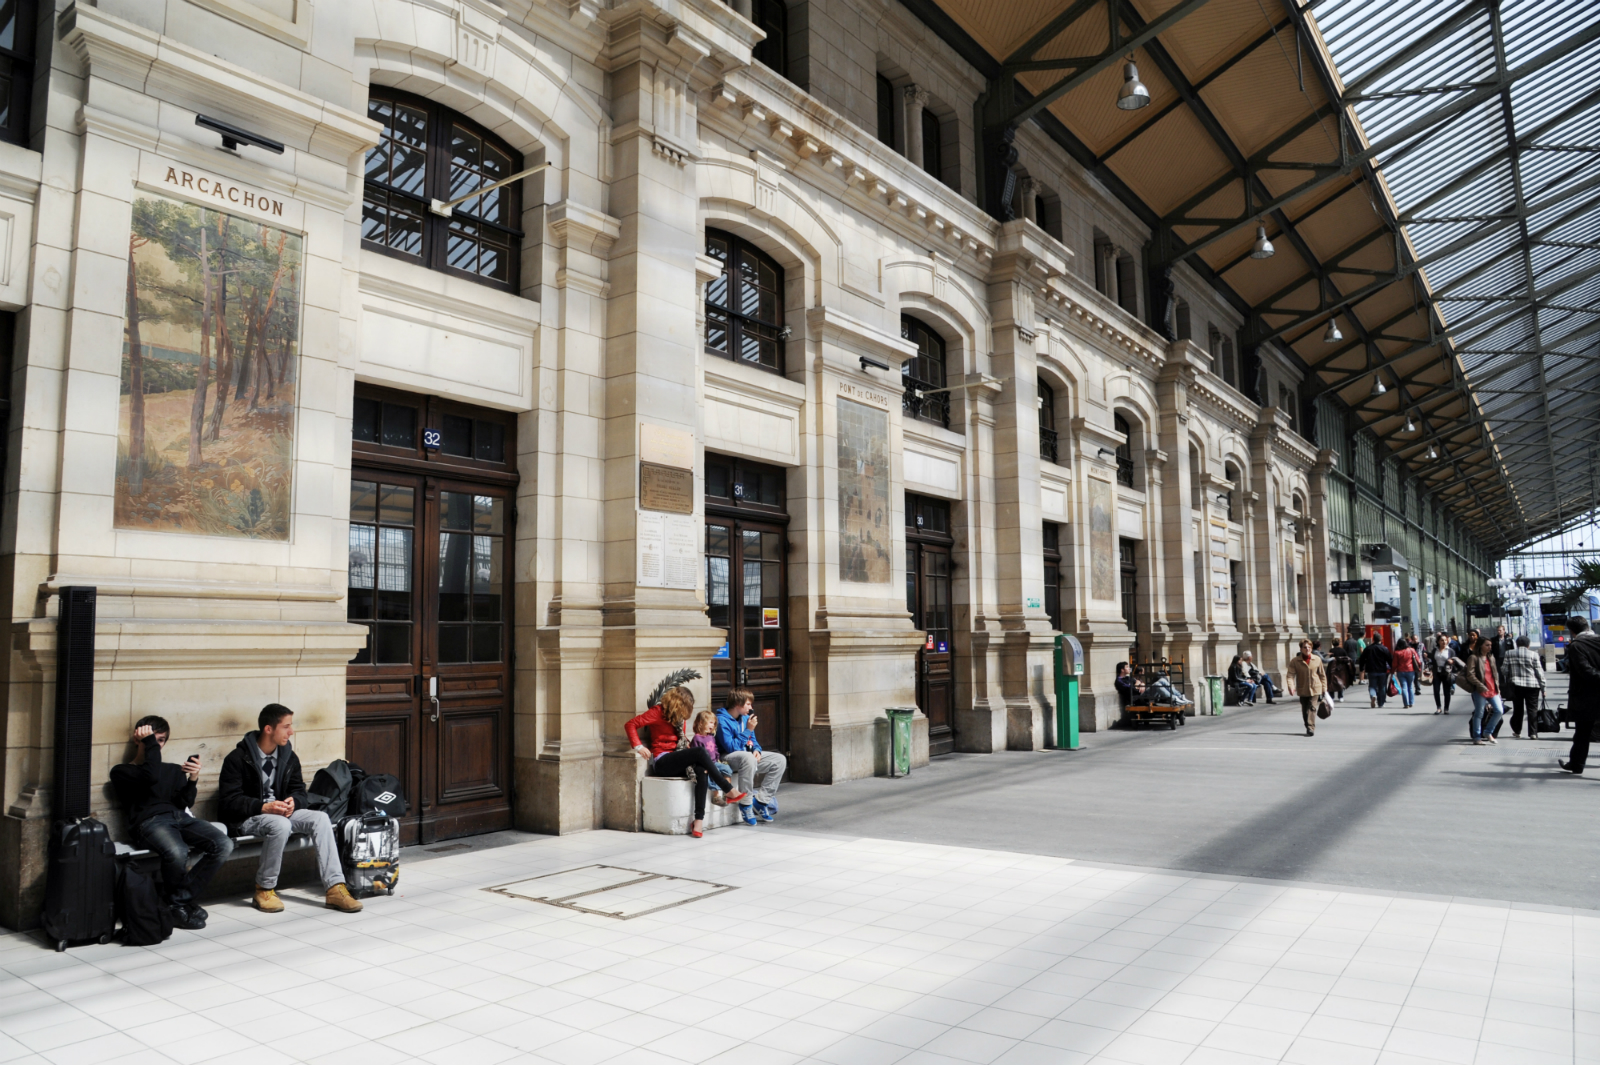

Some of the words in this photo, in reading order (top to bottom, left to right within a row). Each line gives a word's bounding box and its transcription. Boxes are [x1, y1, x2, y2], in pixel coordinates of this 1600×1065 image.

[164, 166, 284, 217] ARCACHON
[840, 382, 856, 396] PONT
[857, 390, 864, 398] DE
[865, 390, 888, 406] CAHORS
[424, 431, 440, 446] 32
[735, 485, 743, 496] 31
[917, 516, 924, 525] 30
[1526, 582, 1534, 590] A
